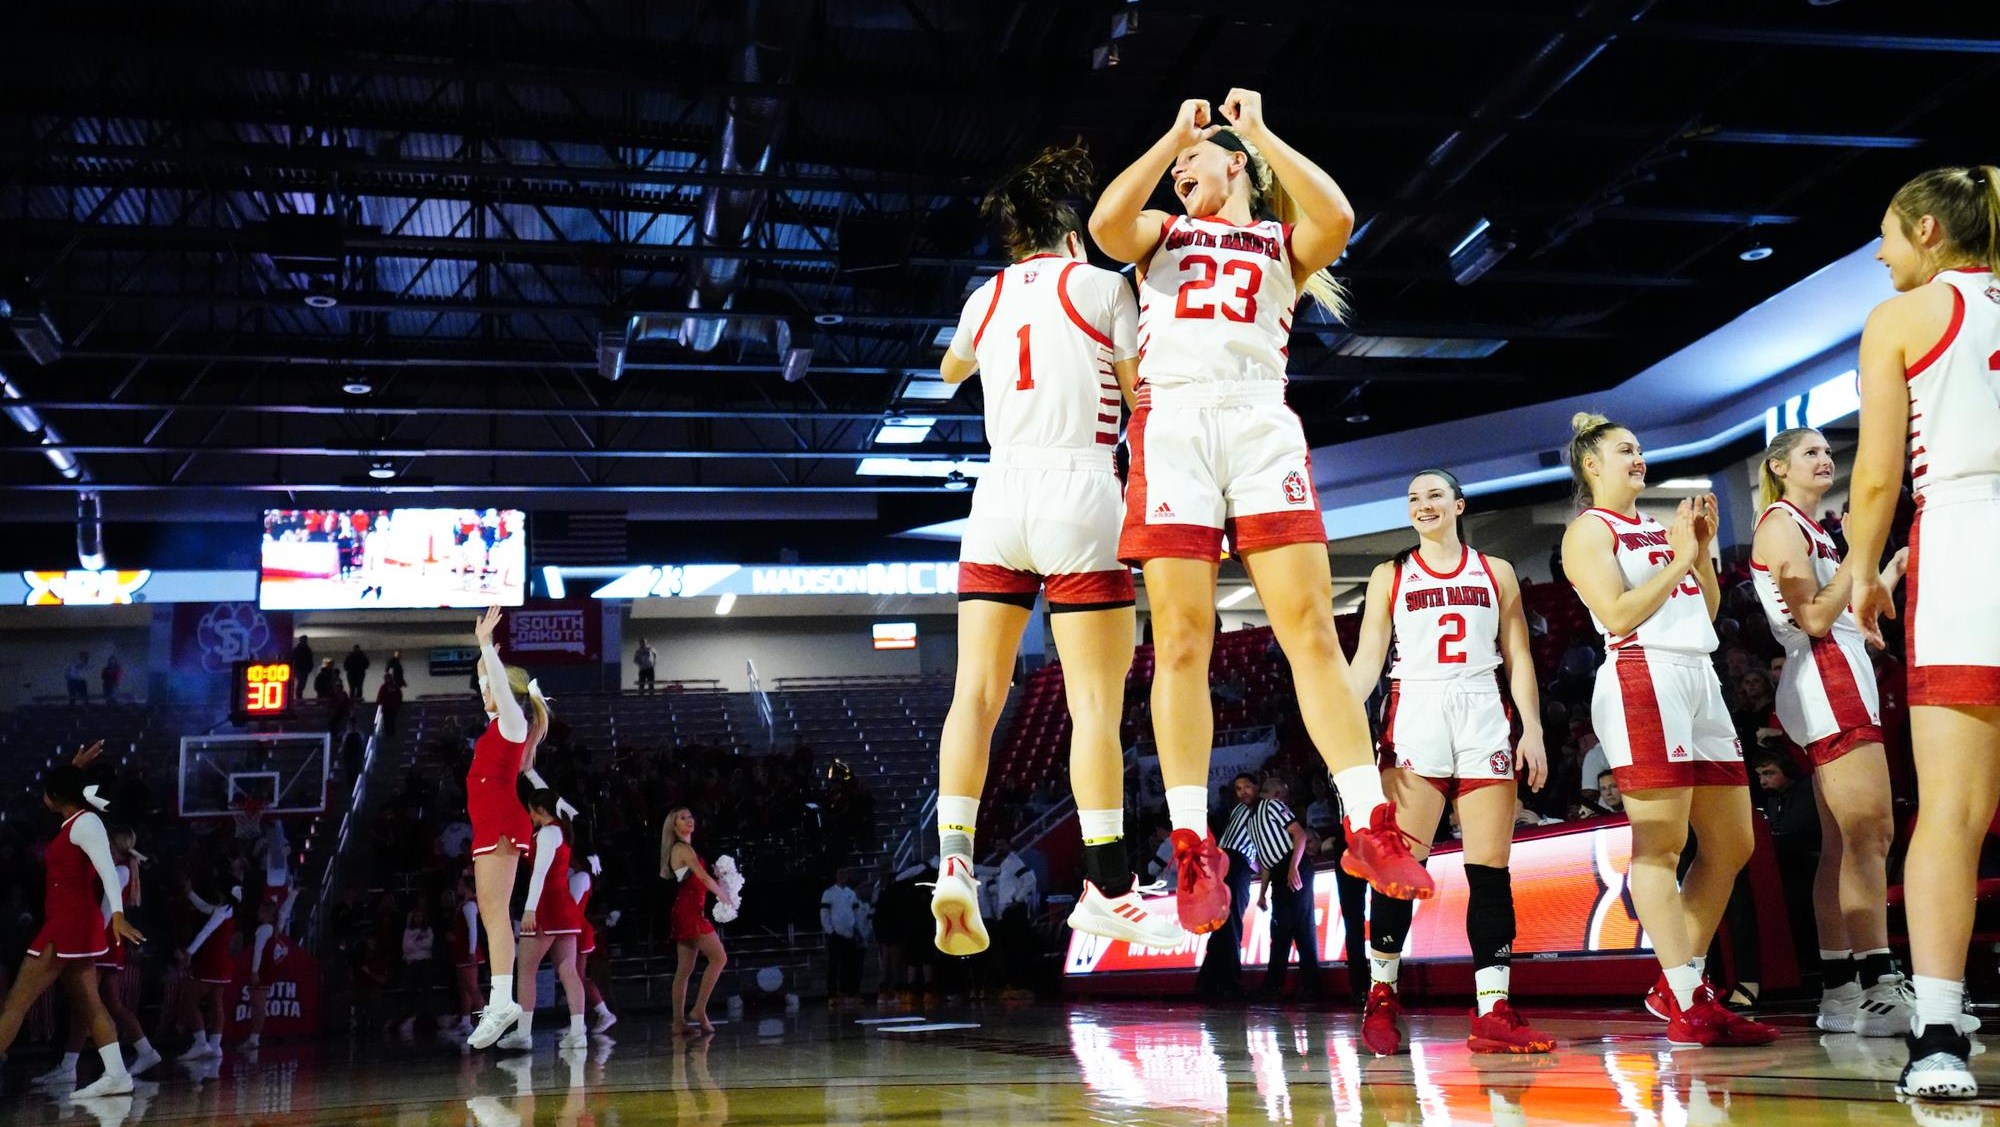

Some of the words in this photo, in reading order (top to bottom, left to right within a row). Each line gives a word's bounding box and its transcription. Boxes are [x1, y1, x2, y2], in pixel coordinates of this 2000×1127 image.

[1166, 228, 1217, 251] SOUTH
[1175, 254, 1263, 324] 23
[1016, 323, 1035, 391] 1
[752, 568, 867, 594] MADISON
[1405, 587, 1445, 612] SOUTH
[1446, 586, 1491, 608] DAKOTA
[517, 616, 584, 631] SOUTH
[517, 629, 584, 643] DAKOTA
[1438, 613, 1467, 663] 2
[247, 664, 290, 682] 10:00
[247, 681, 283, 710] 30
[241, 982, 297, 1001] SUTH
